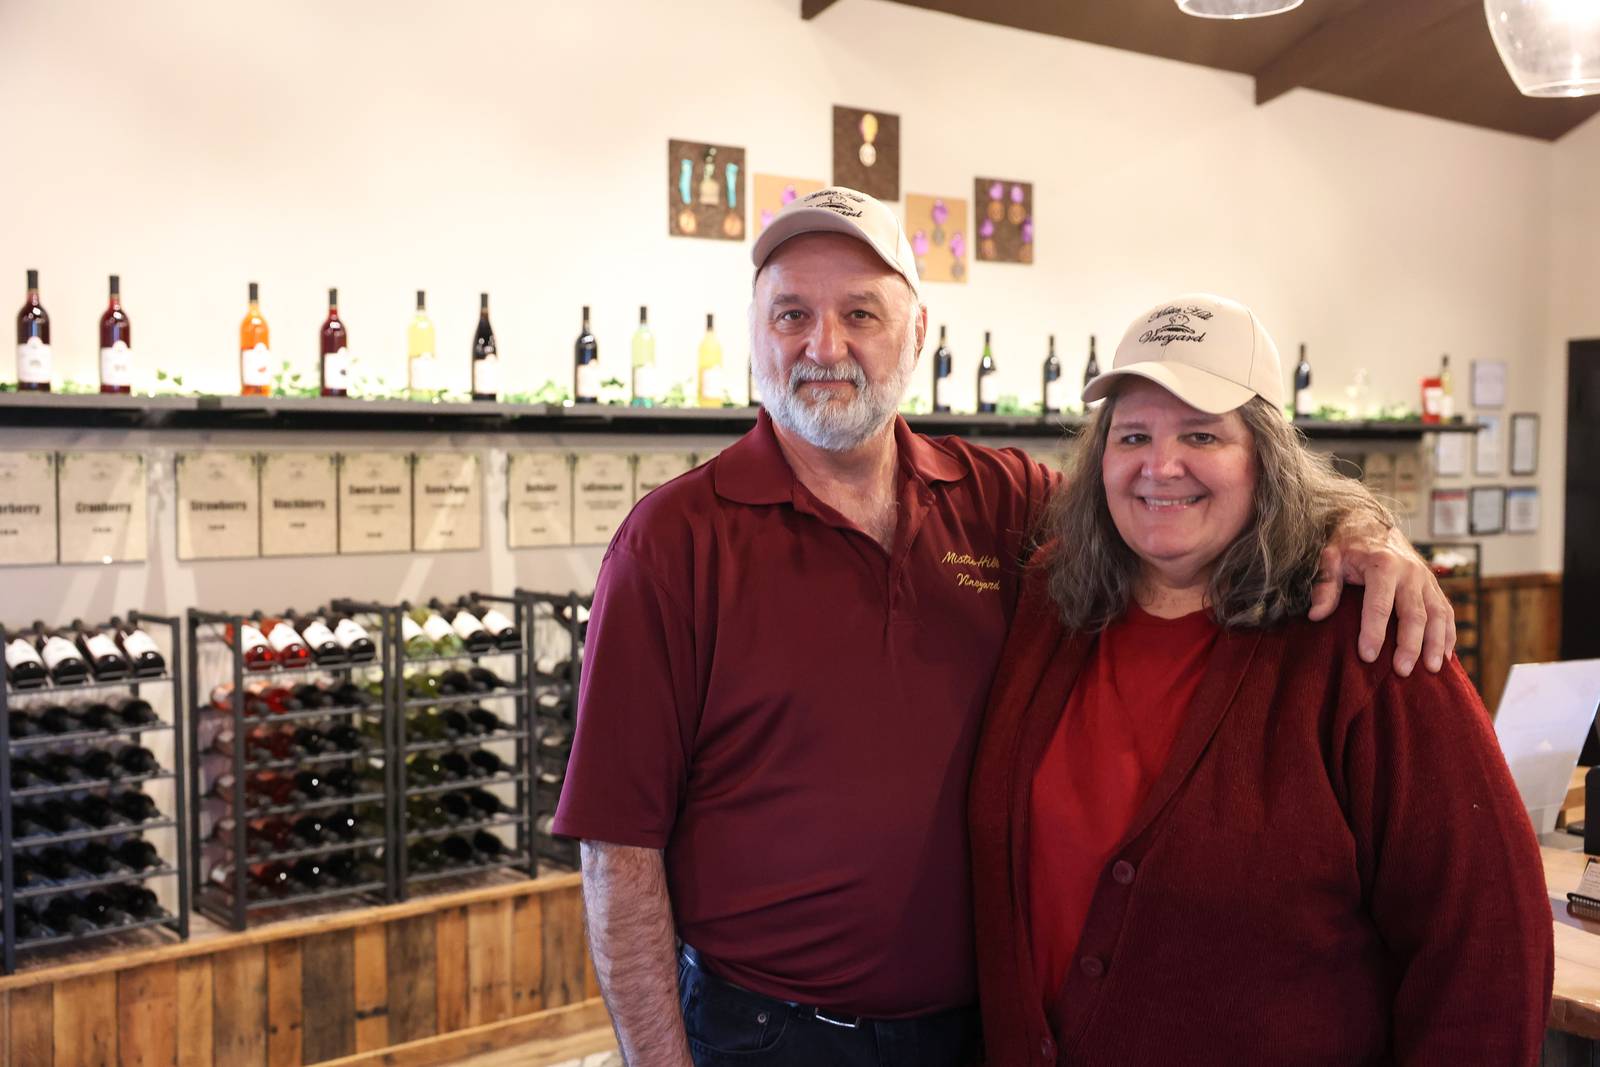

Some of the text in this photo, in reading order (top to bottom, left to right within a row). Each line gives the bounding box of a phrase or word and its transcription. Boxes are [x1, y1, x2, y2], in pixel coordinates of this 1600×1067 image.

[1138, 329, 1206, 346] Vineyard
[75, 501, 132, 515] Cranberry
[190, 499, 247, 512] Strawberry
[272, 498, 326, 511] Blackberry
[956, 572, 1001, 594] Vineyard
